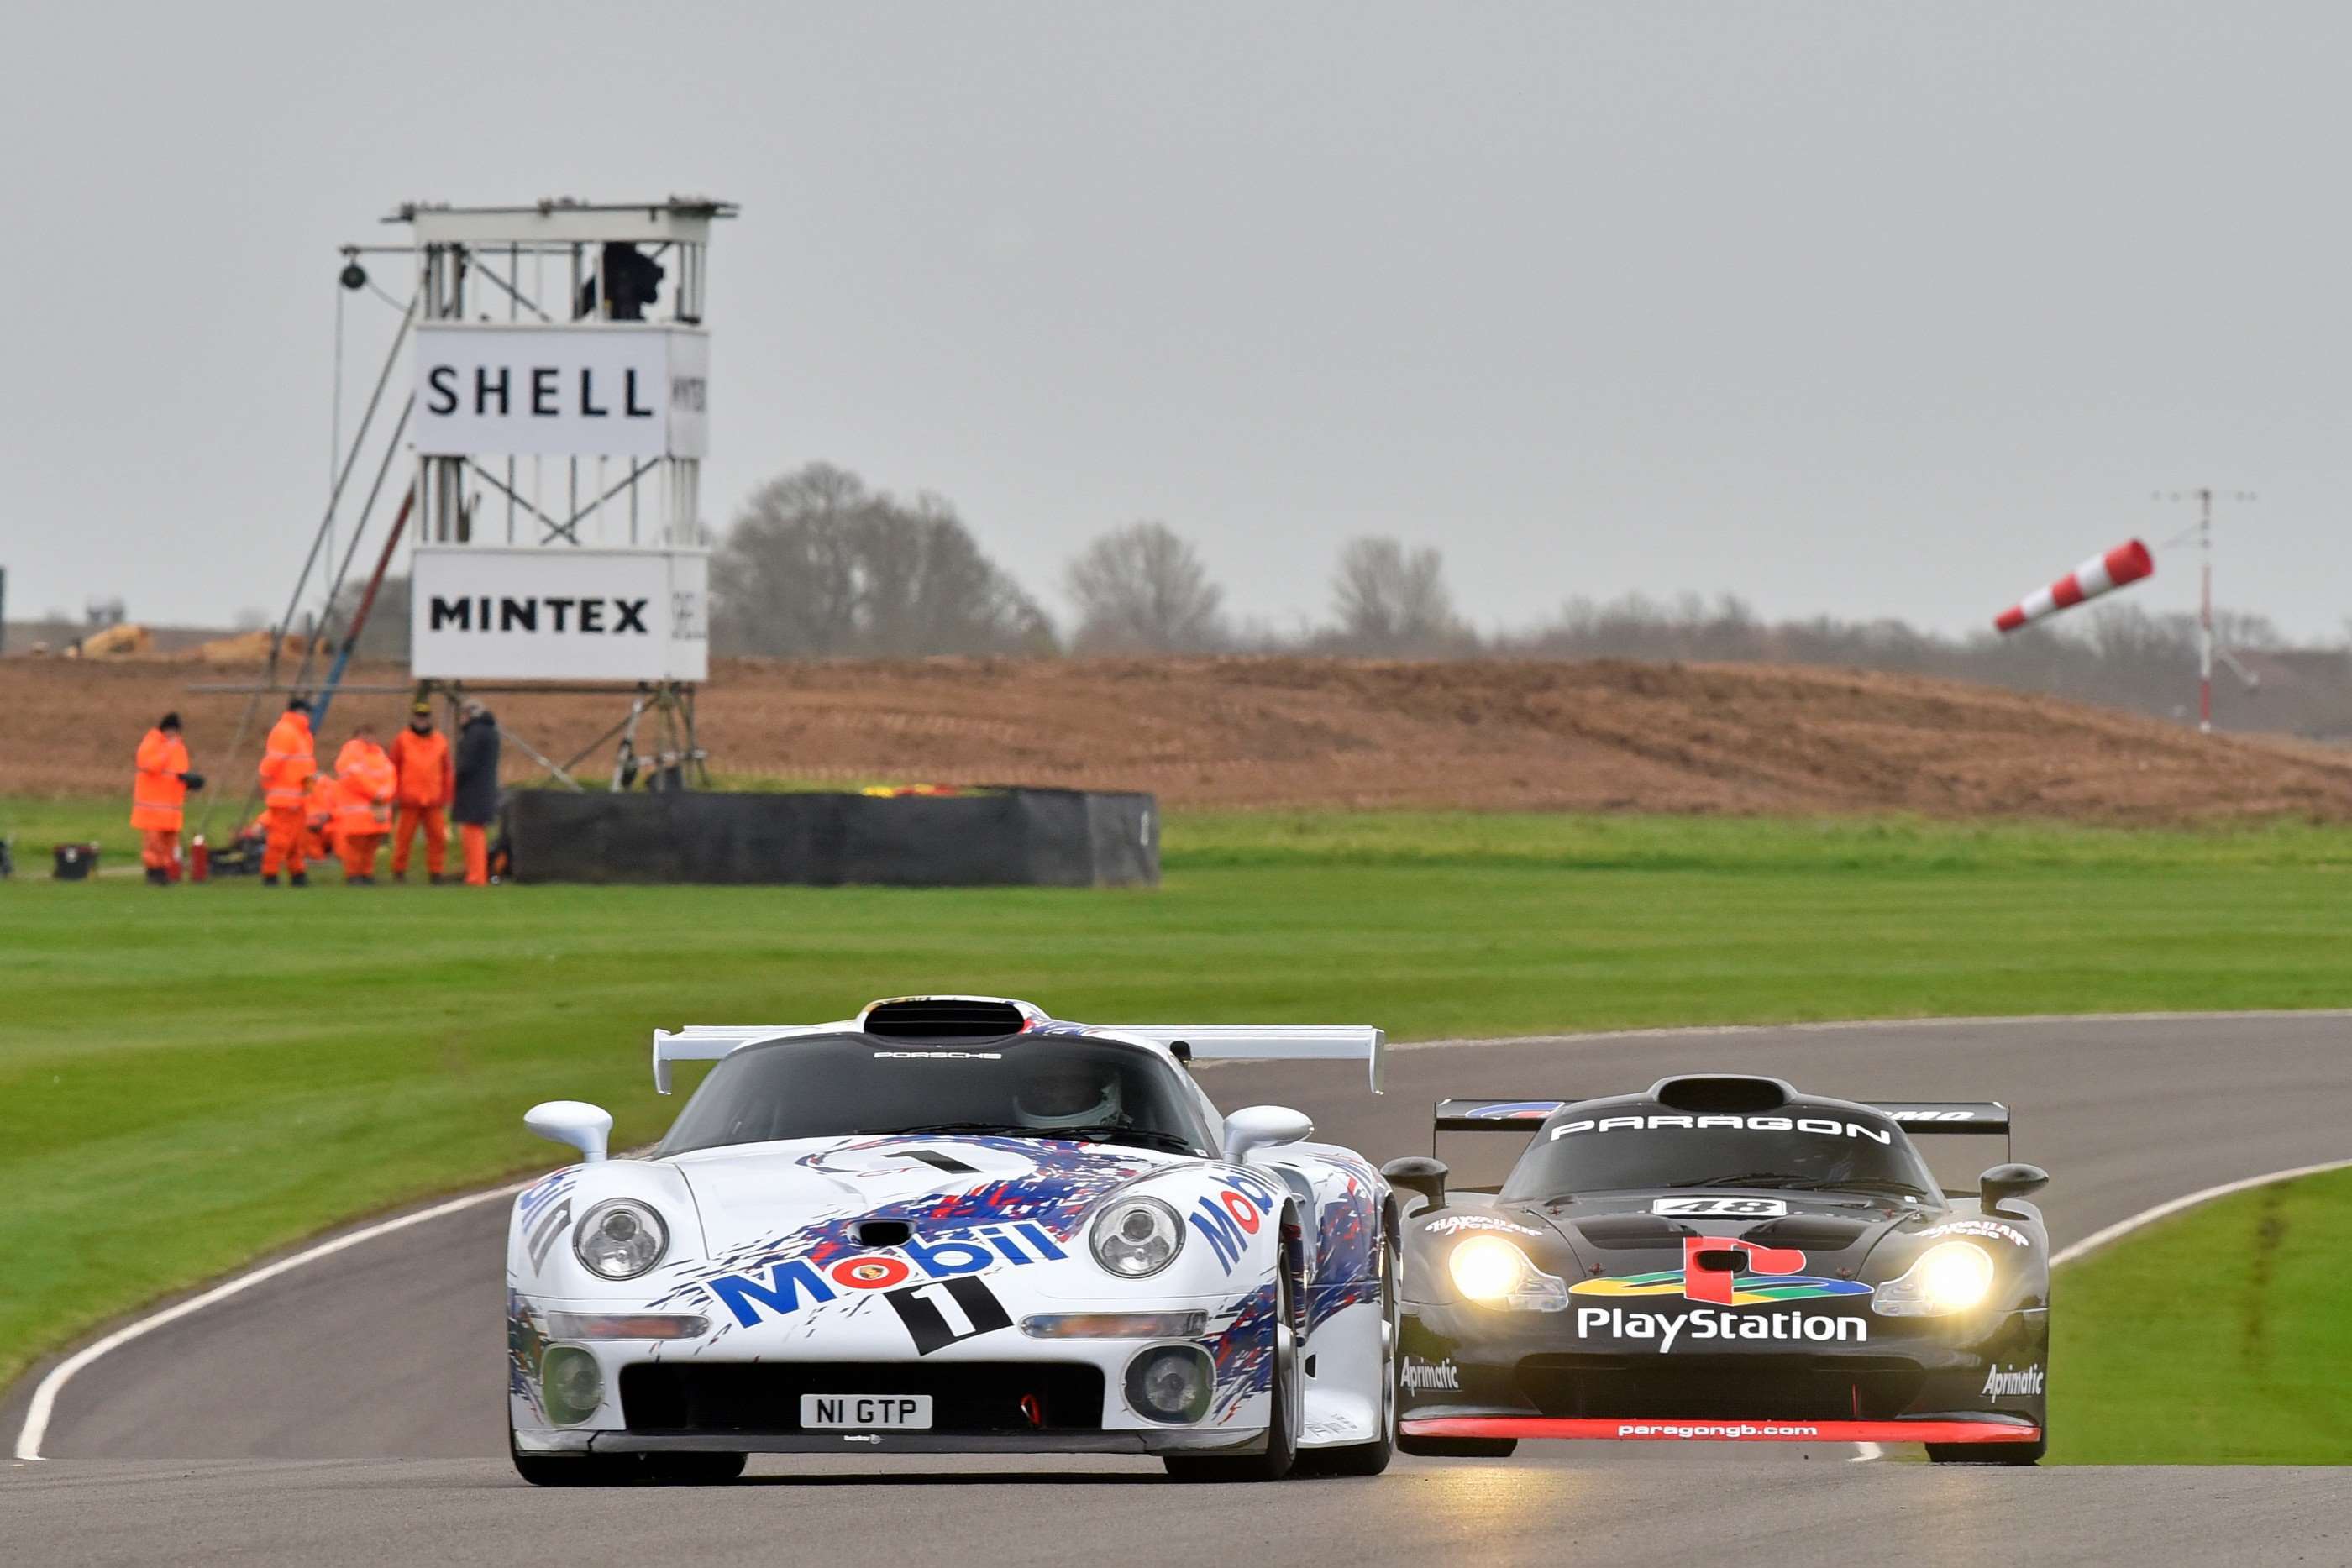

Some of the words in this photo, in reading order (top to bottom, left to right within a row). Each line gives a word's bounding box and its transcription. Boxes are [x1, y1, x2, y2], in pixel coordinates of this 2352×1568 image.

[427, 364, 654, 417] SHELL
[430, 596, 648, 634] MINTEX
[874, 1051, 1002, 1060] PORSCHE
[1550, 1115, 1892, 1145] PARAGON
[1664, 1200, 1777, 1213] 48
[707, 1221, 1069, 1329] Mobil
[1578, 1308, 1867, 1354] PlayStation
[1399, 1356, 1459, 1398] Aprimatic
[1982, 1363, 2044, 1404] Aprimatic
[857, 1399, 916, 1424] GTP
[1617, 1424, 1818, 1438] paragongb.com
